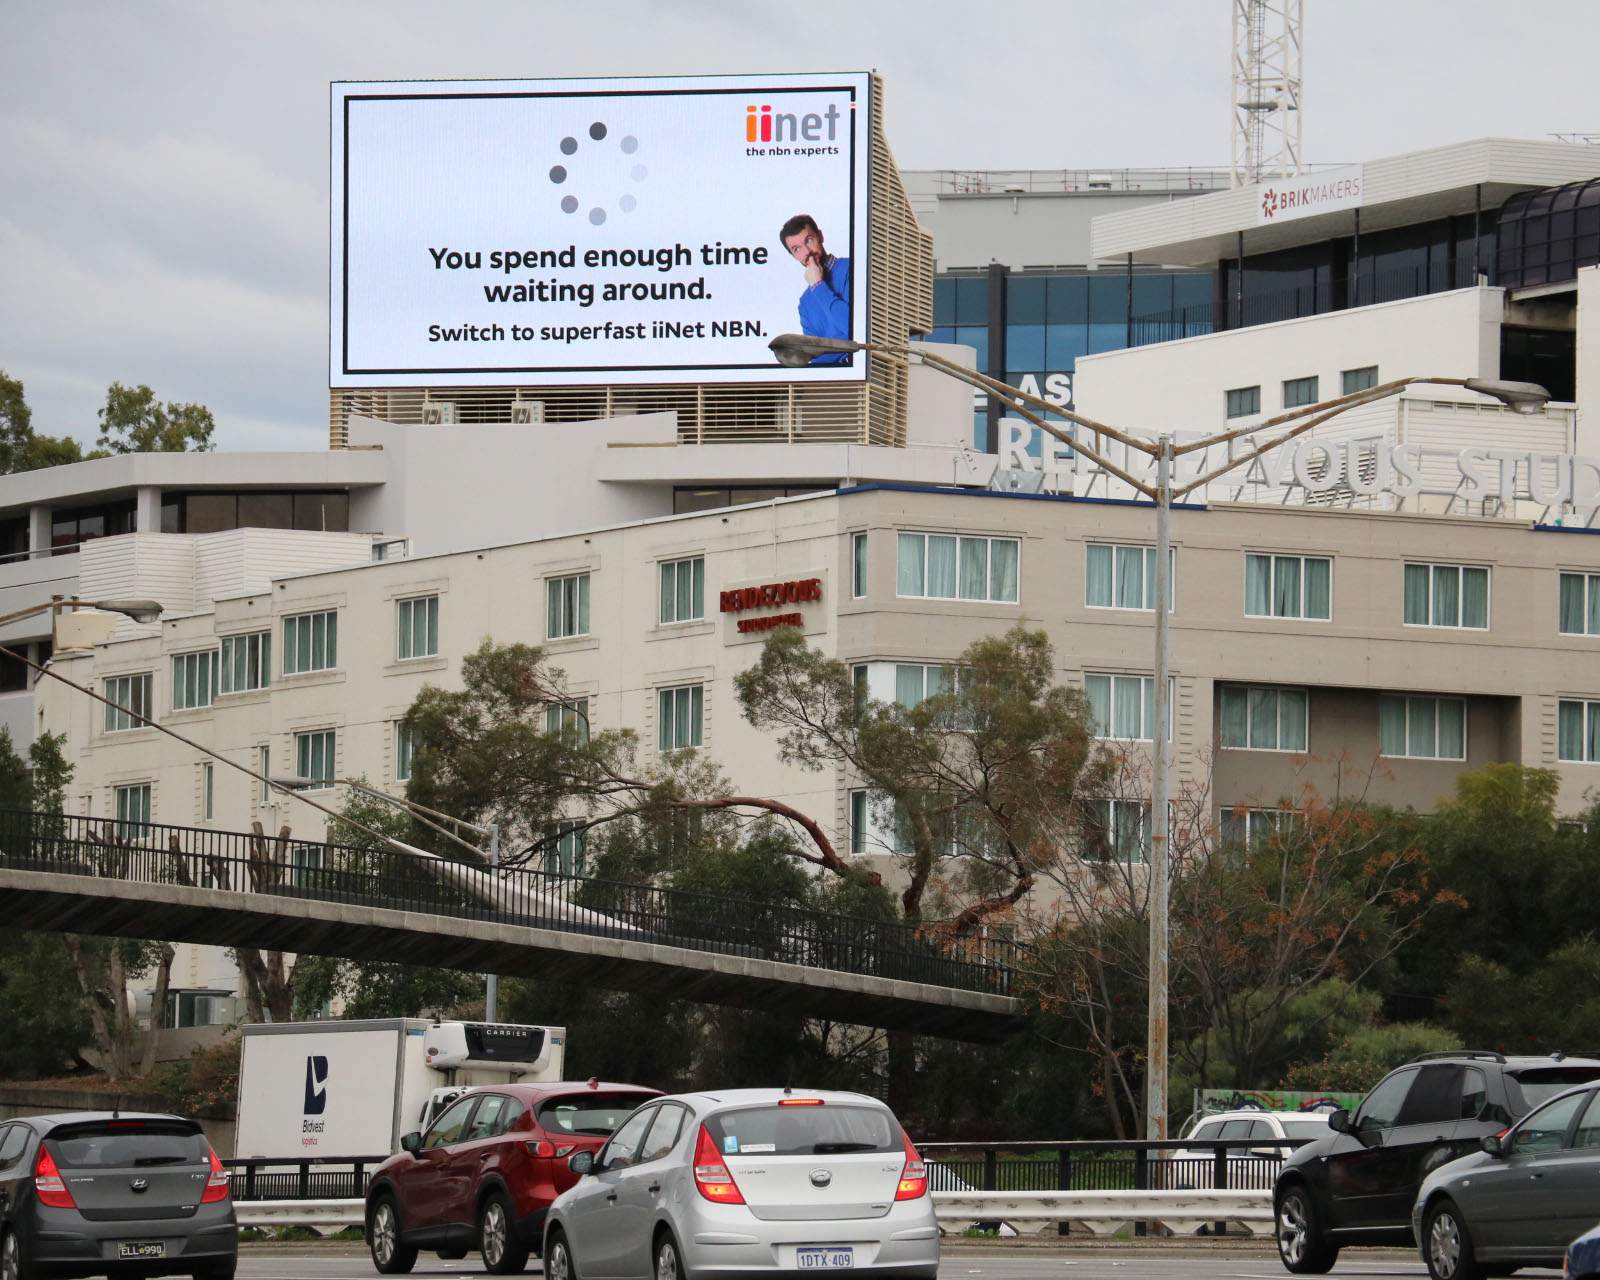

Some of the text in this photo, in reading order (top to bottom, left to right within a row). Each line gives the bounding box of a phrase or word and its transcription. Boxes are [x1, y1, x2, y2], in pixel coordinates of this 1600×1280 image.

[746, 103, 840, 142] iinet
[746, 146, 839, 156] the nbn experts
[1280, 178, 1360, 209] BRIKMAKERS
[428, 241, 769, 274] You spend enough time
[483, 277, 712, 307] waiting around.
[428, 320, 768, 344] Switch to superfast iiNet NBN.
[486, 1029, 527, 1037] CARRIER
